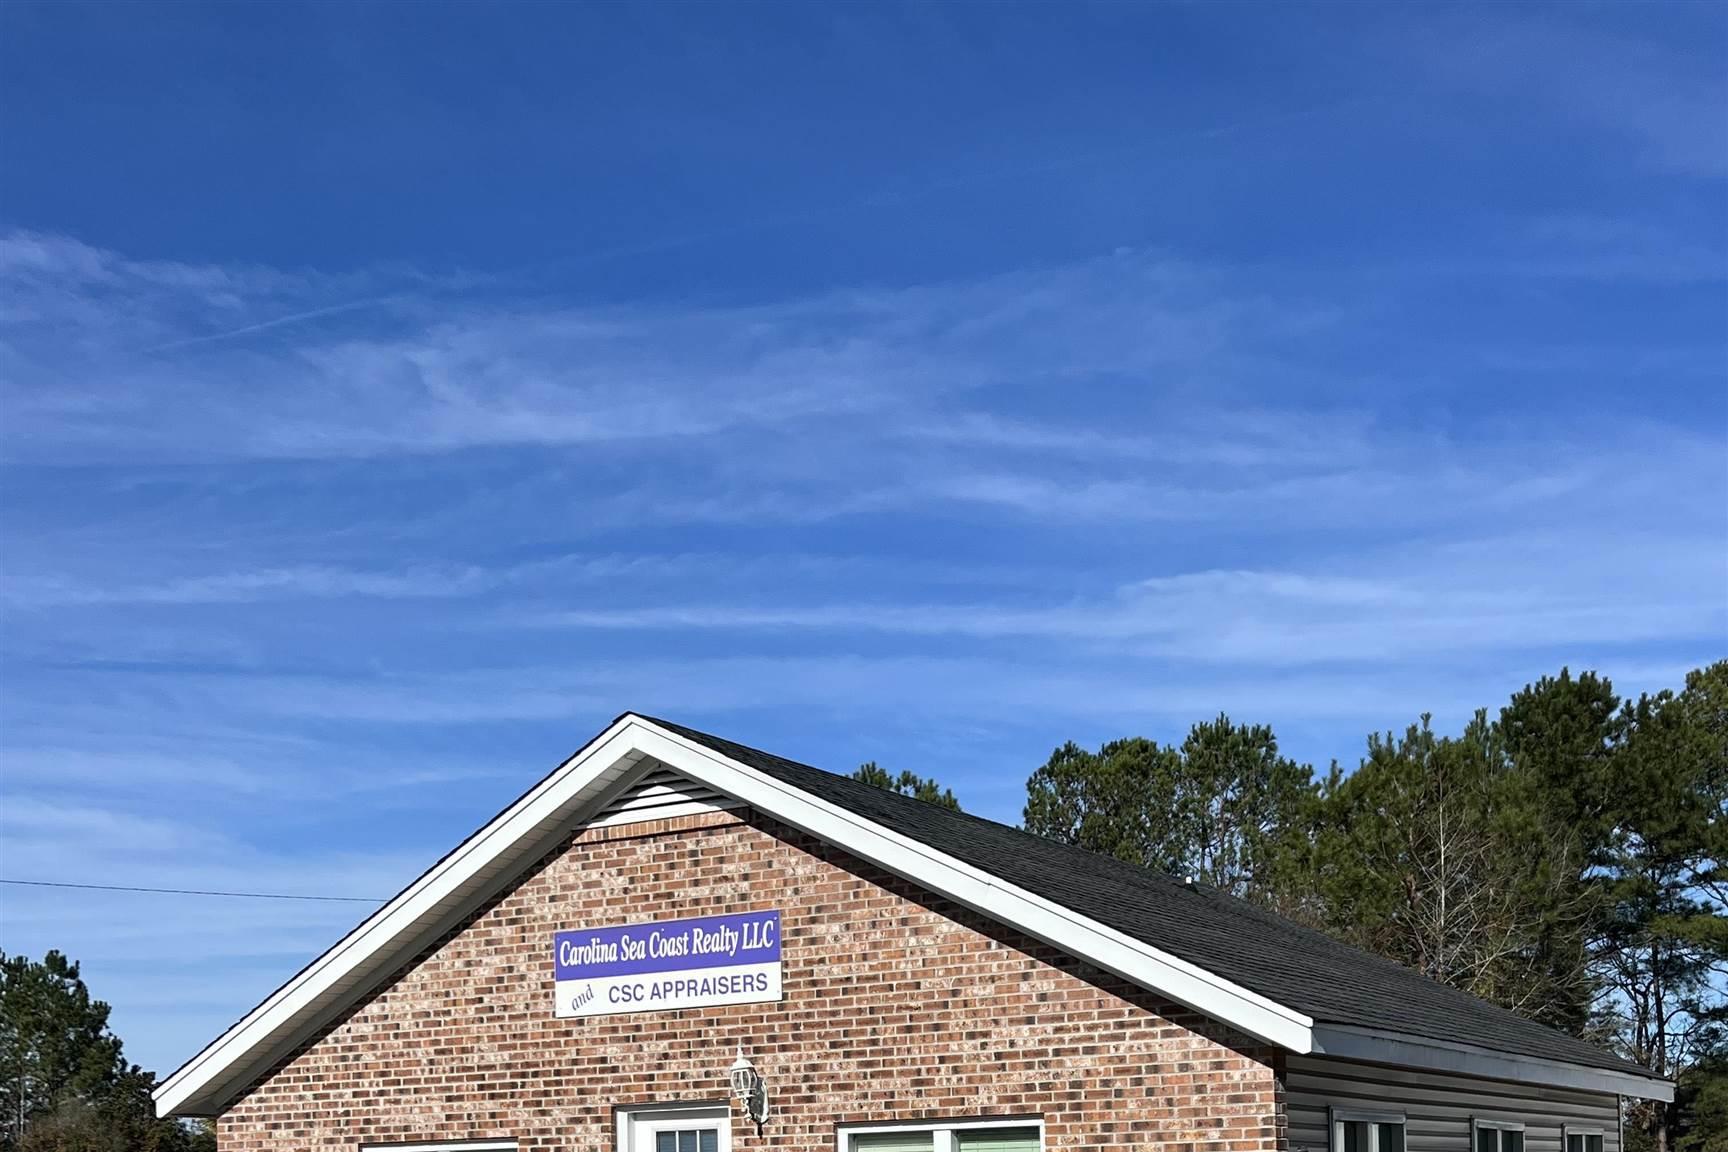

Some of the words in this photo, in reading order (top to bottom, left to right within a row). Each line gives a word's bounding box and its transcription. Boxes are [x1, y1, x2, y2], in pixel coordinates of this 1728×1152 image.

[559, 938, 618, 967] Carolina
[620, 934, 646, 961] Sea
[649, 931, 689, 959] Coast
[691, 924, 739, 957] Realty
[742, 920, 774, 949] LLC
[571, 984, 595, 1011] and
[608, 984, 645, 1003] CSC
[650, 973, 768, 1000] APPRAISERS
